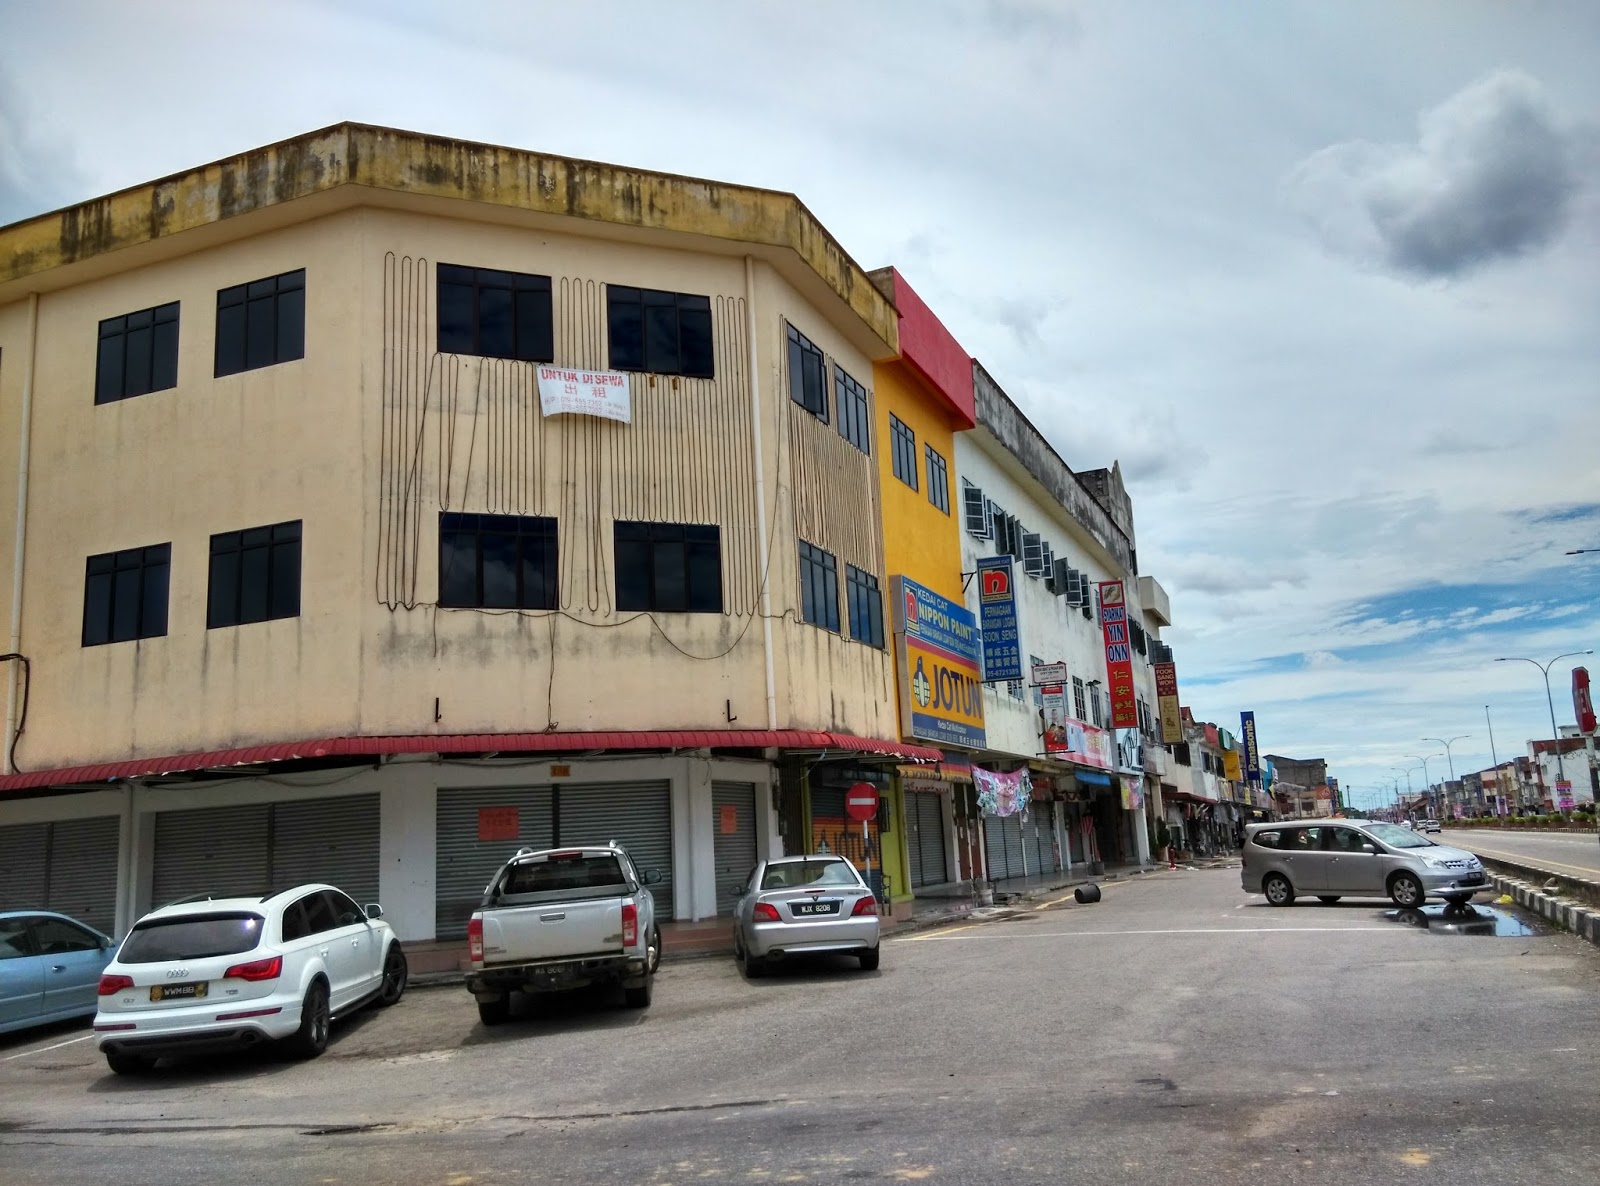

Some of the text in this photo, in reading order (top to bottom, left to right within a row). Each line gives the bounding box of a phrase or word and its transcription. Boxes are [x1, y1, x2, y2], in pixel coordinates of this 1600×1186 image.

[541, 368, 578, 382] UNTUK
[918, 588, 948, 612] KEDAI CAT
[919, 602, 949, 631] NIPPON
[950, 618, 973, 641] PAINT
[1103, 606, 1125, 622] SYARIKAT
[984, 629, 1017, 642] SOON SENG
[1106, 624, 1125, 642] YIN
[1107, 643, 1129, 663] ONN
[933, 664, 982, 719] JOTUN
[1244, 720, 1257, 772] Panasonic
[815, 904, 831, 912] 8208
